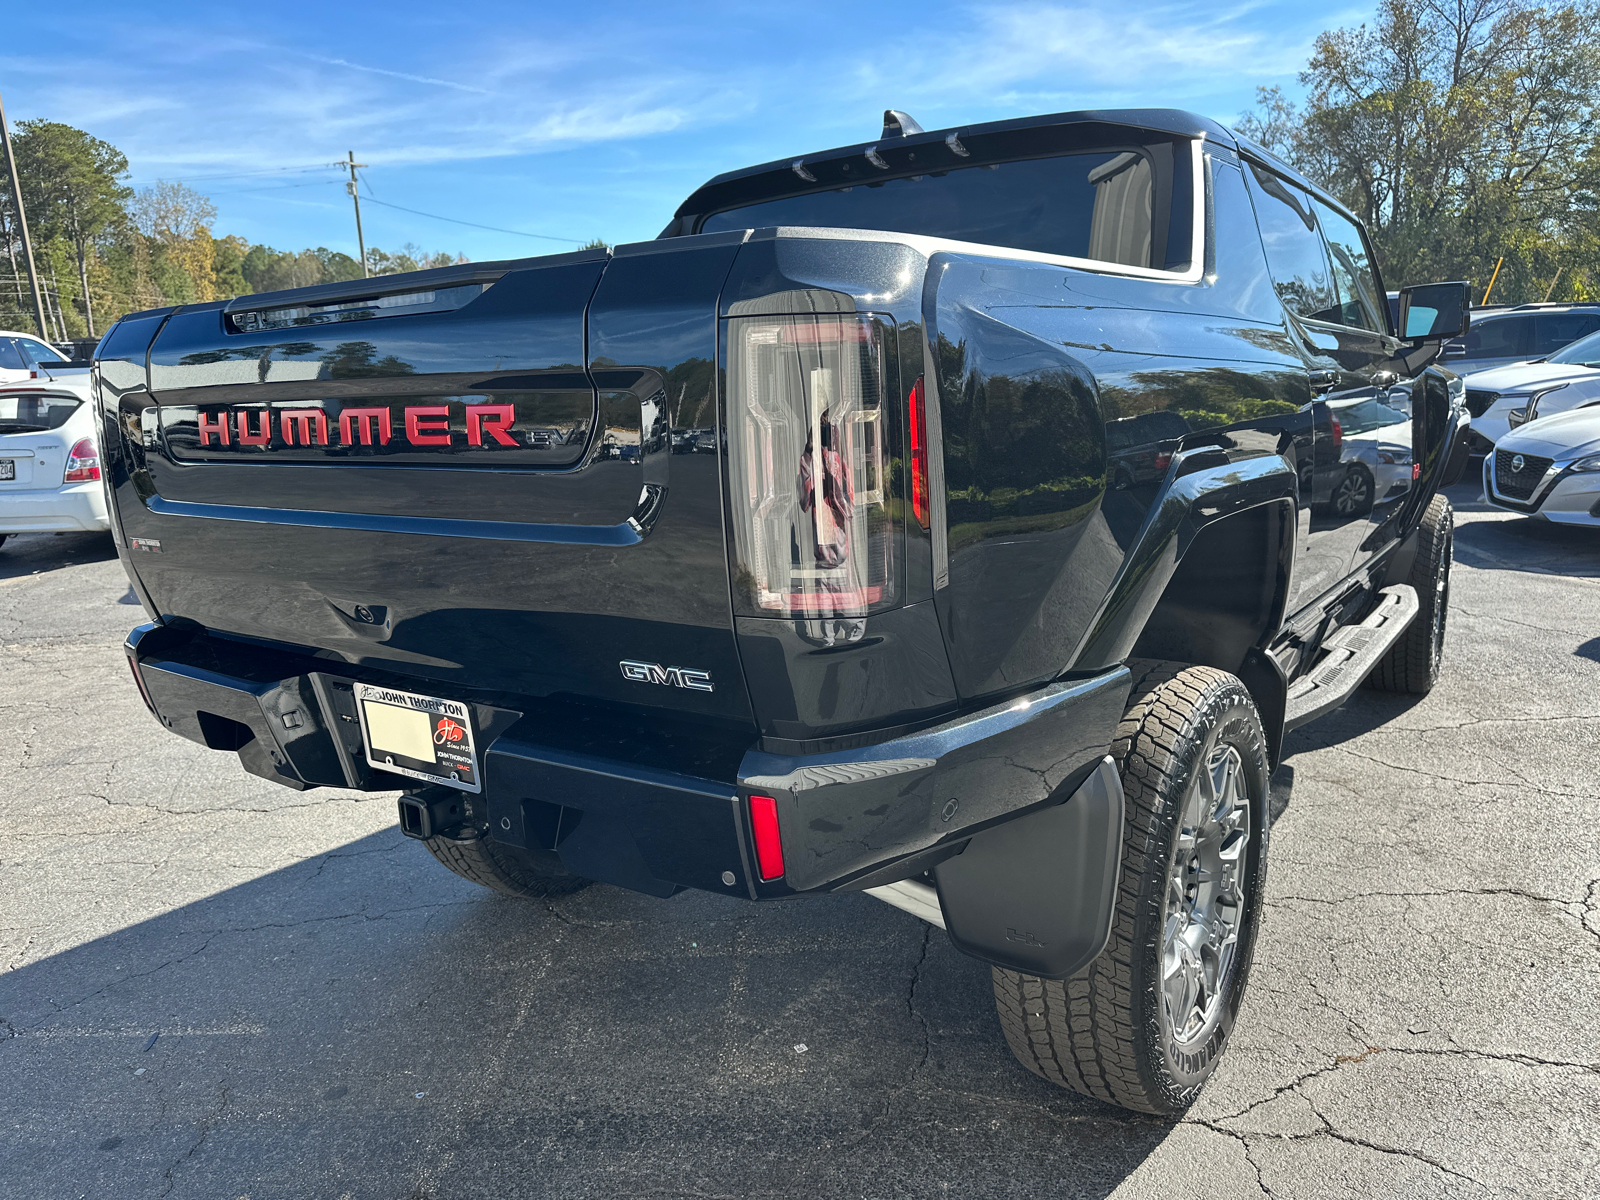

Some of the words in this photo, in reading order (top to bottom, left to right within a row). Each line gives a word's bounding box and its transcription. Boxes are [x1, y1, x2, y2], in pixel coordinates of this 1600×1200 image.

[198, 403, 520, 447] HUMMER
[525, 428, 575, 446] EV
[619, 659, 715, 693] GMC
[379, 690, 408, 705] JOHN
[408, 696, 464, 717] THORNTON
[437, 751, 449, 759] JOHN
[456, 763, 471, 772] GMC
